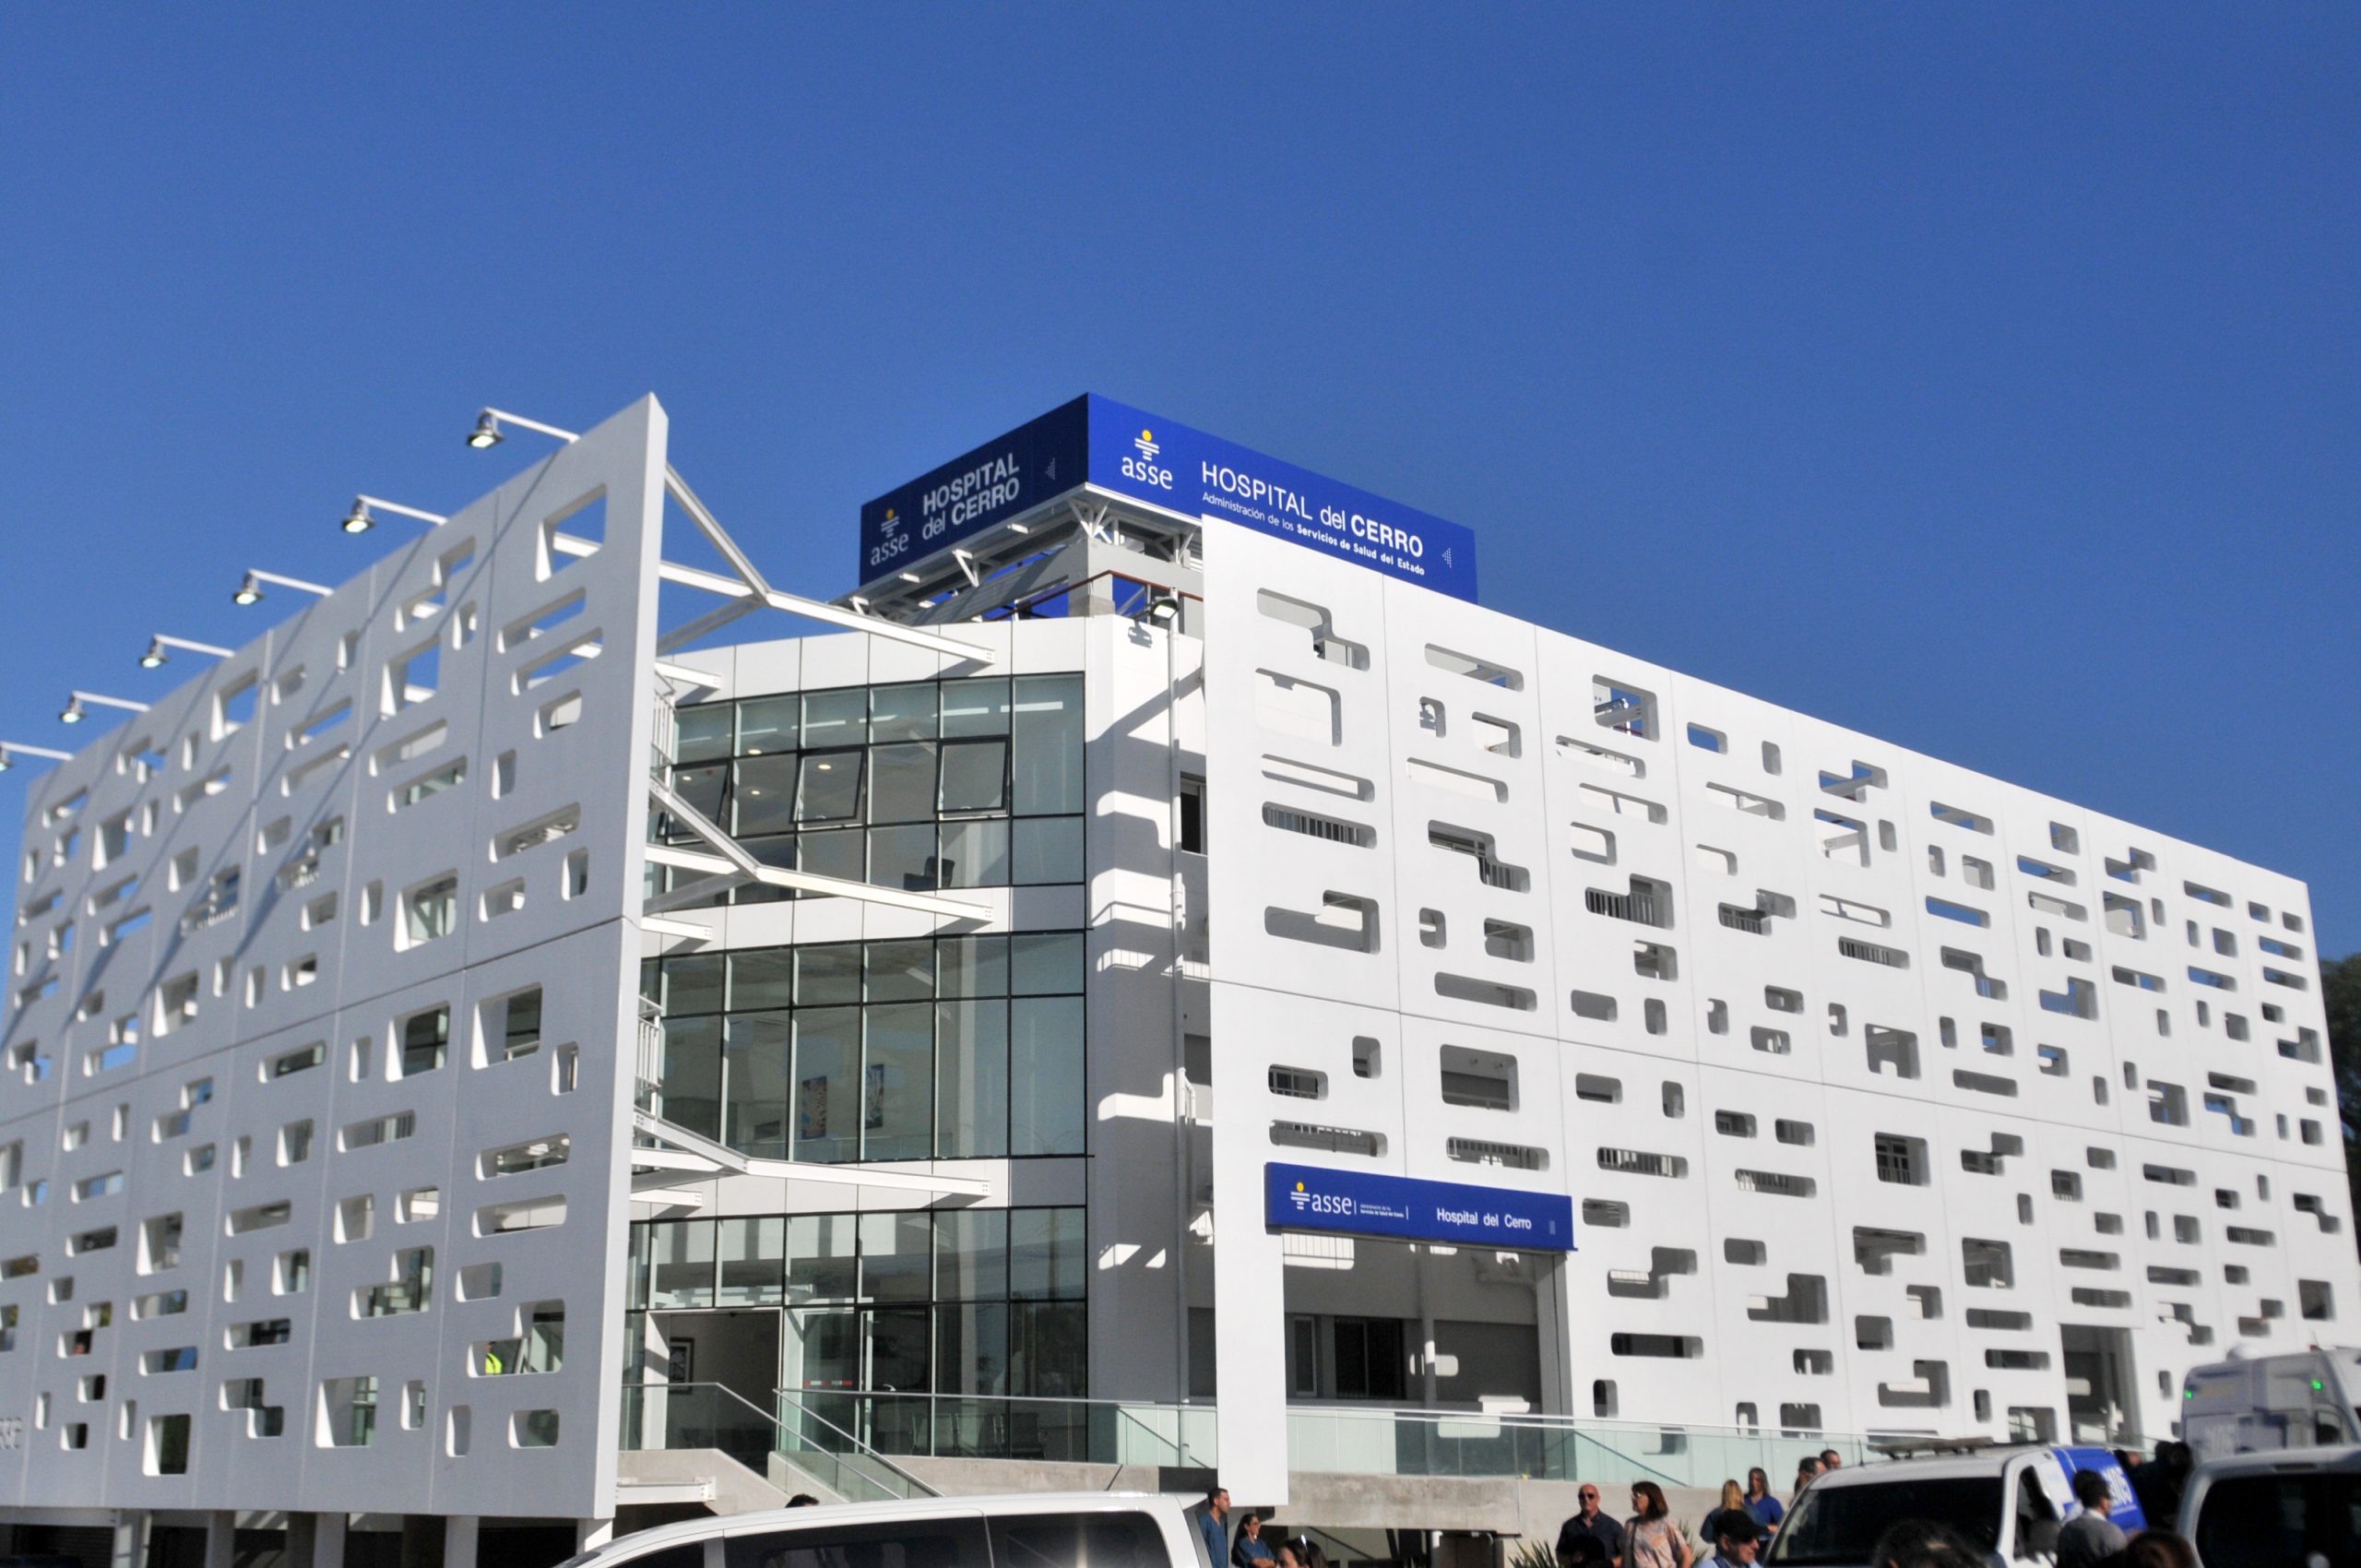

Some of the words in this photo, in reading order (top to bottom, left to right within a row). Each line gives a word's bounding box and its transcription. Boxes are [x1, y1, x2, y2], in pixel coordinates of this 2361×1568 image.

[922, 453, 1020, 515] HOSPITAL
[1121, 457, 1173, 490] asse
[922, 515, 946, 540] del
[951, 477, 1020, 524] CERRO
[1202, 460, 1313, 519] HOSPITAL
[1320, 505, 1347, 531] del
[1350, 514, 1423, 557] CERRO
[870, 531, 909, 565] asse
[1203, 492, 1265, 521] Administración
[1267, 514, 1280, 525] de
[1282, 517, 1294, 531] los
[1297, 524, 1338, 546] Servicios
[1339, 539, 1351, 551] de
[1353, 542, 1377, 559] Salud
[1381, 552, 1394, 565] del
[1397, 557, 1425, 576] Estado
[1311, 1194, 1352, 1215] asse
[1437, 1207, 1478, 1225] Hospital
[1483, 1214, 1499, 1227] del
[1504, 1215, 1532, 1229] Cerro
